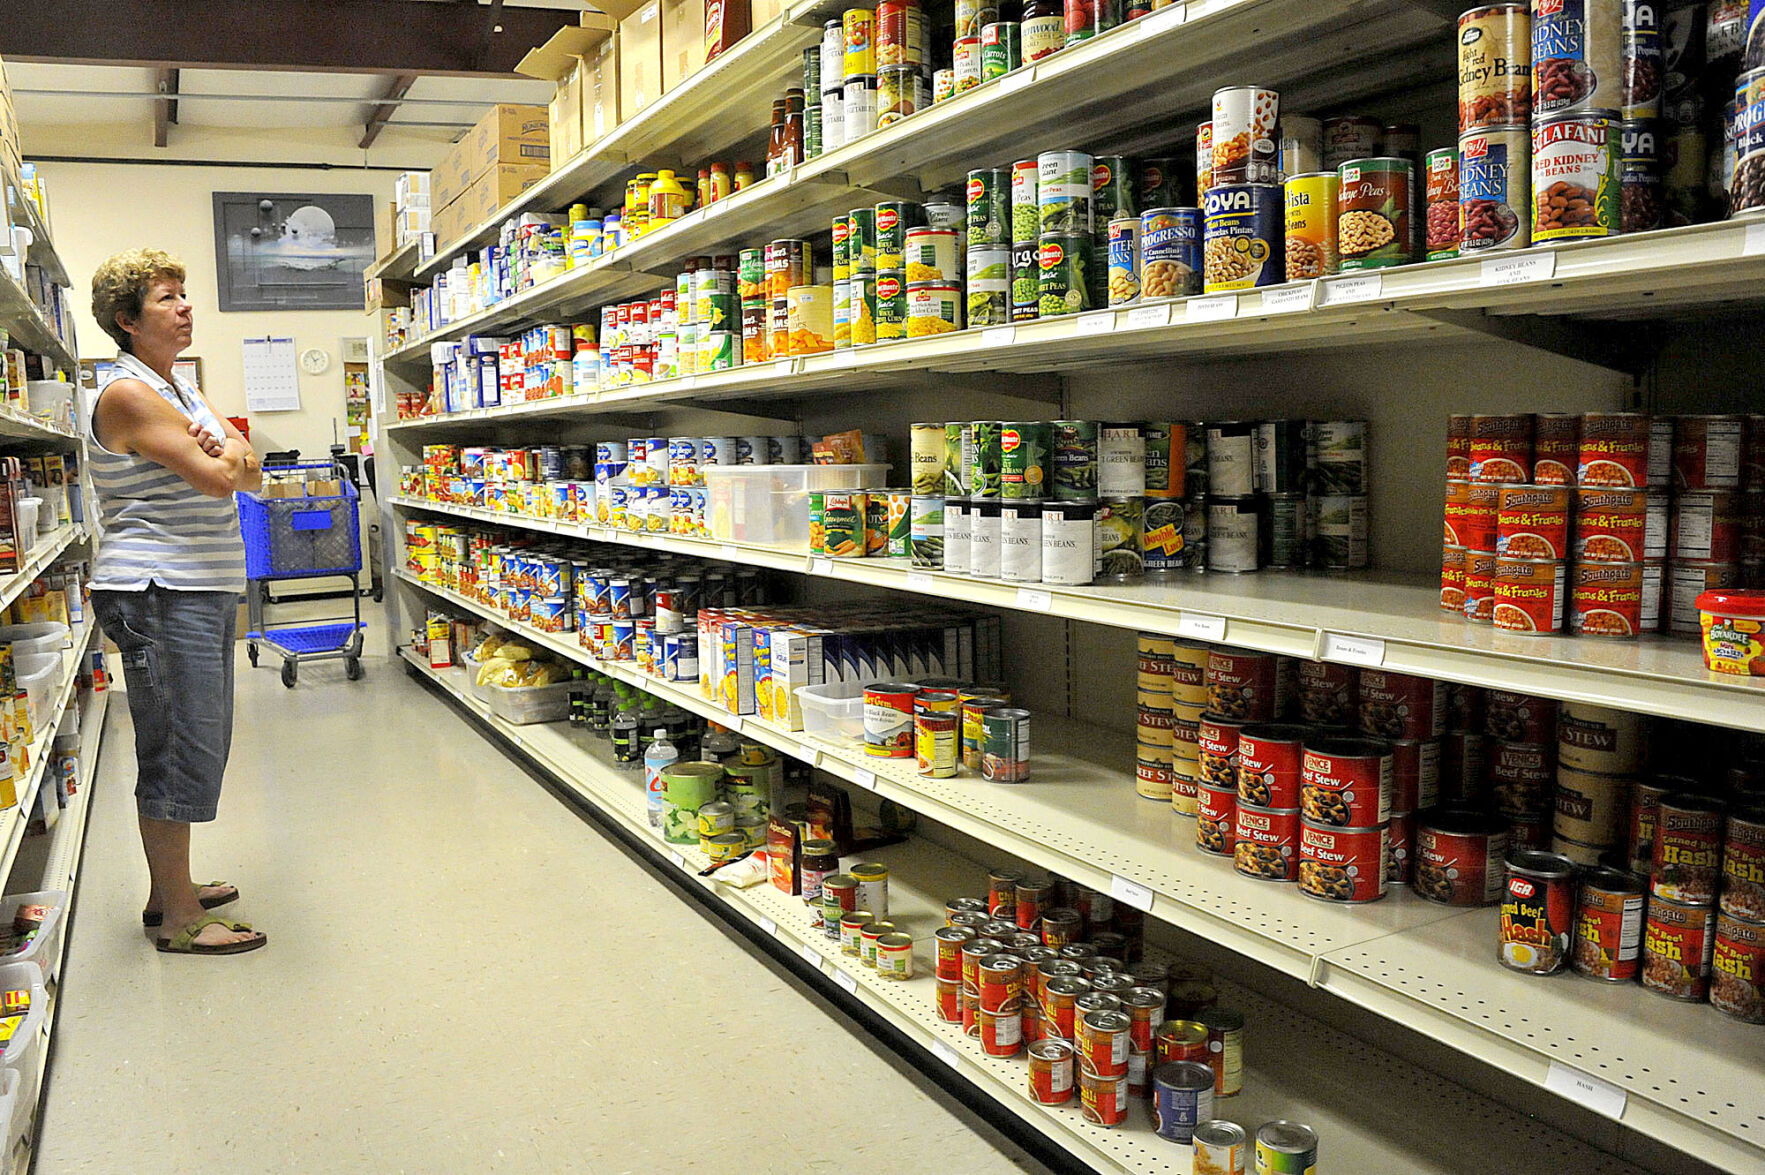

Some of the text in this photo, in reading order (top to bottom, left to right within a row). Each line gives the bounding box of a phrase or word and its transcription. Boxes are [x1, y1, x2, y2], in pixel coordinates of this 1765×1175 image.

[1494, 58, 1531, 77] Bean
[1553, 153, 1599, 166] KIDNEY
[1545, 164, 1581, 177] BEANS
[1359, 182, 1385, 200] Peas
[1103, 429, 1139, 439] HART
[1492, 439, 1503, 451] &
[1597, 440, 1609, 453] &
[914, 452, 938, 463] Beans
[1504, 491, 1554, 510] Southgate
[1582, 494, 1634, 510] Southgate
[824, 511, 856, 524] Gourmet
[1519, 513, 1532, 526] &
[1532, 513, 1564, 527] Franks
[1597, 515, 1610, 529] &
[1144, 526, 1176, 547] Double
[1579, 568, 1632, 584] Southgate
[1501, 584, 1549, 599] & Franks
[1597, 588, 1609, 602] &
[1709, 628, 1750, 645] BOYARDEE
[1217, 671, 1241, 684] Stew
[874, 697, 892, 708] Gem
[1564, 727, 1610, 747] STEW
[1205, 740, 1228, 753] Stew
[1242, 755, 1262, 769] Stew
[1304, 755, 1330, 768] VENICE
[1314, 771, 1341, 787] Stew
[1240, 813, 1269, 827] VENICE
[1253, 828, 1280, 843] Stew
[1305, 831, 1334, 845] VENICE
[1662, 834, 1698, 848] Corned
[1316, 846, 1345, 862] Stew
[1662, 845, 1720, 867] Hash
[1509, 880, 1532, 896] IGA
[1520, 903, 1544, 918] Beef
[1501, 914, 1552, 948] Hash
[1576, 1080, 1594, 1092] HASH
